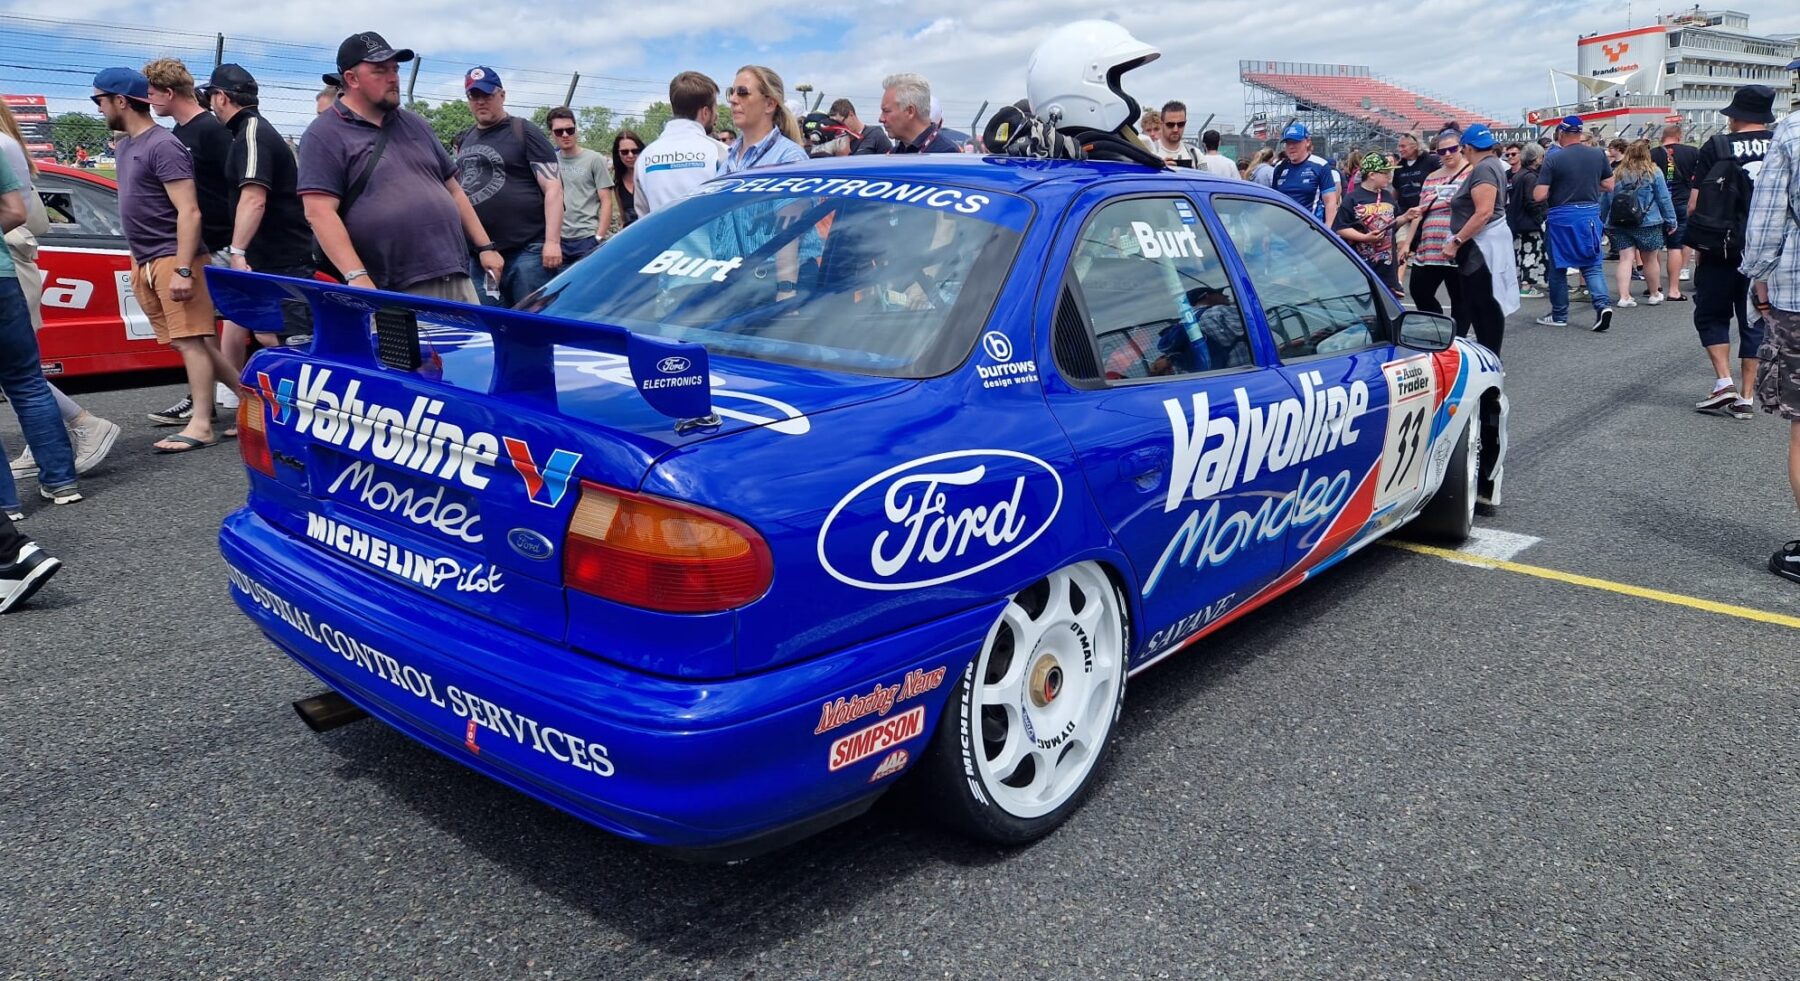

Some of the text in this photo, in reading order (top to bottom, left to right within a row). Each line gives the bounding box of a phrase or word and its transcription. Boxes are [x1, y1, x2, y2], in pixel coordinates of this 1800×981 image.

[1592, 63, 1639, 77] BrandsHatch
[732, 177, 990, 213] ELECTRONICS
[1131, 221, 1204, 258] Burt
[639, 250, 744, 283] Burt
[643, 375, 703, 390] ELECTRONICS
[662, 358, 685, 371] Ford
[976, 360, 1036, 379] burrows
[984, 374, 1039, 389] design works
[1398, 376, 1430, 396] Trader
[1403, 366, 1423, 381] Auto
[295, 363, 499, 490] Valvoline
[1163, 370, 1369, 513] Valvoline
[871, 464, 1027, 577] Ford
[1141, 468, 1351, 599] Mondeo
[306, 511, 505, 593] MICHELIN Pilot
[1070, 622, 1093, 673] DYMAG
[1139, 592, 1236, 659] SAVANE
[320, 623, 446, 708] CONTROL
[446, 685, 615, 777] SERVICES
[814, 666, 946, 735] Motoring News
[960, 661, 974, 776] MICHELIN
[832, 709, 921, 768] SIMPSON
[1037, 720, 1076, 750] DYMAG
